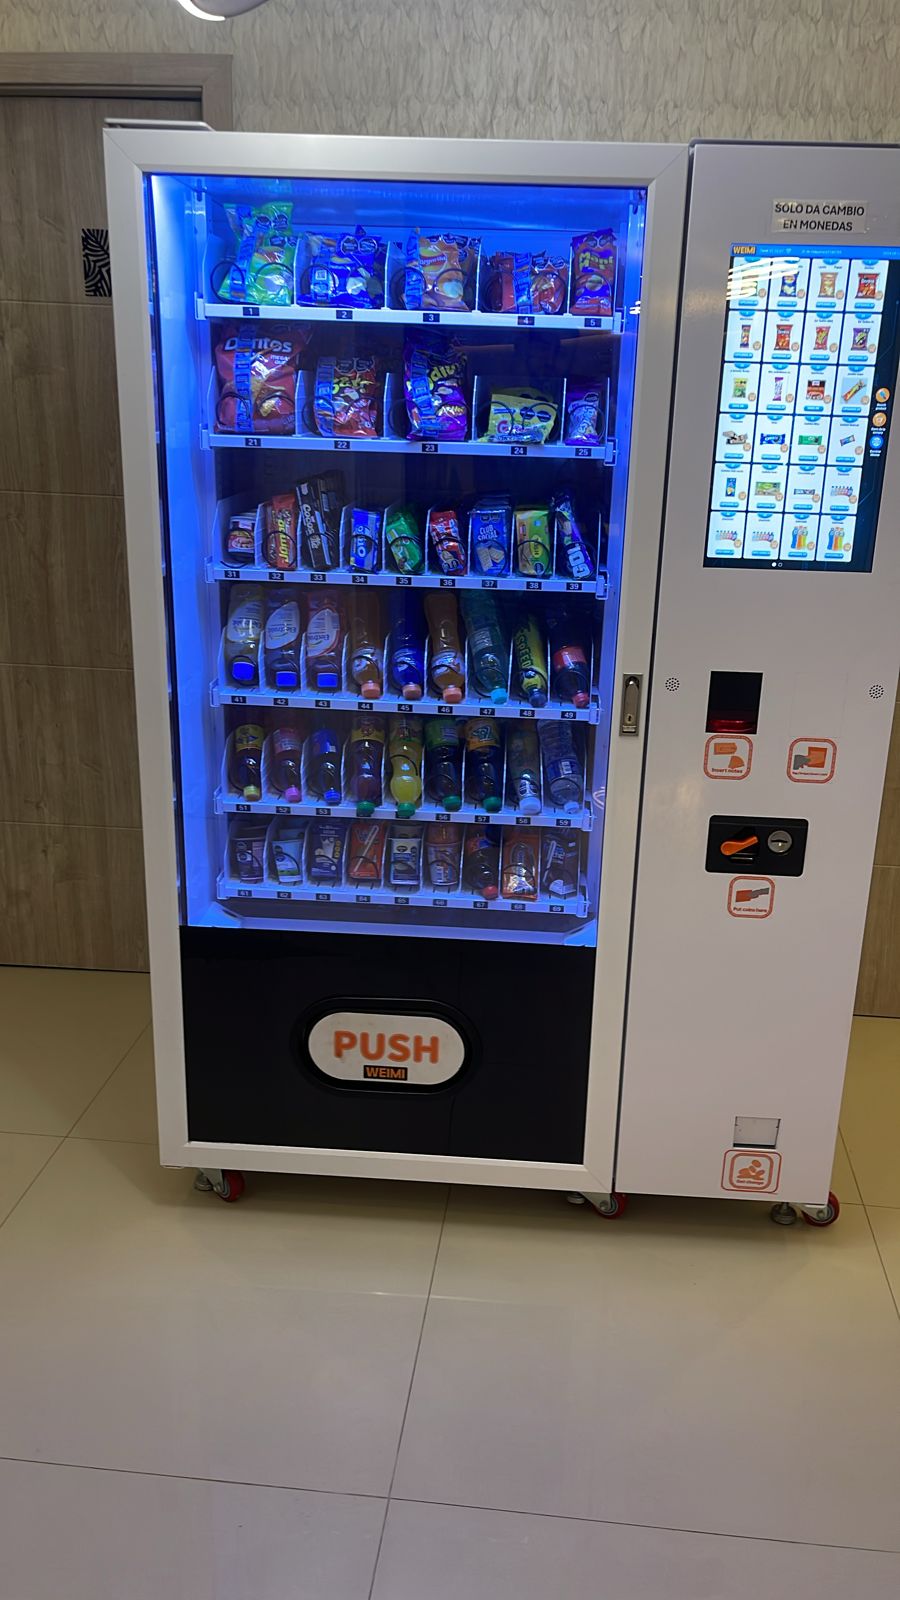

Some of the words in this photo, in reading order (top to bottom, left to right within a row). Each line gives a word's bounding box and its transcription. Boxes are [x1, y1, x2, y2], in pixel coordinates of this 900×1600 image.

[775, 202, 803, 213] SOLO
[806, 204, 820, 214] DA
[822, 205, 865, 216] CAMBIO
[783, 219, 797, 229] EN
[800, 220, 853, 231] MONEDAS
[733, 246, 755, 254] WEIMI
[224, 337, 293, 353] Dritos
[514, 446, 524, 454] 24
[399, 576, 408, 584] 35
[333, 1030, 439, 1064] PUSH
[365, 1067, 406, 1079] WEIMI
